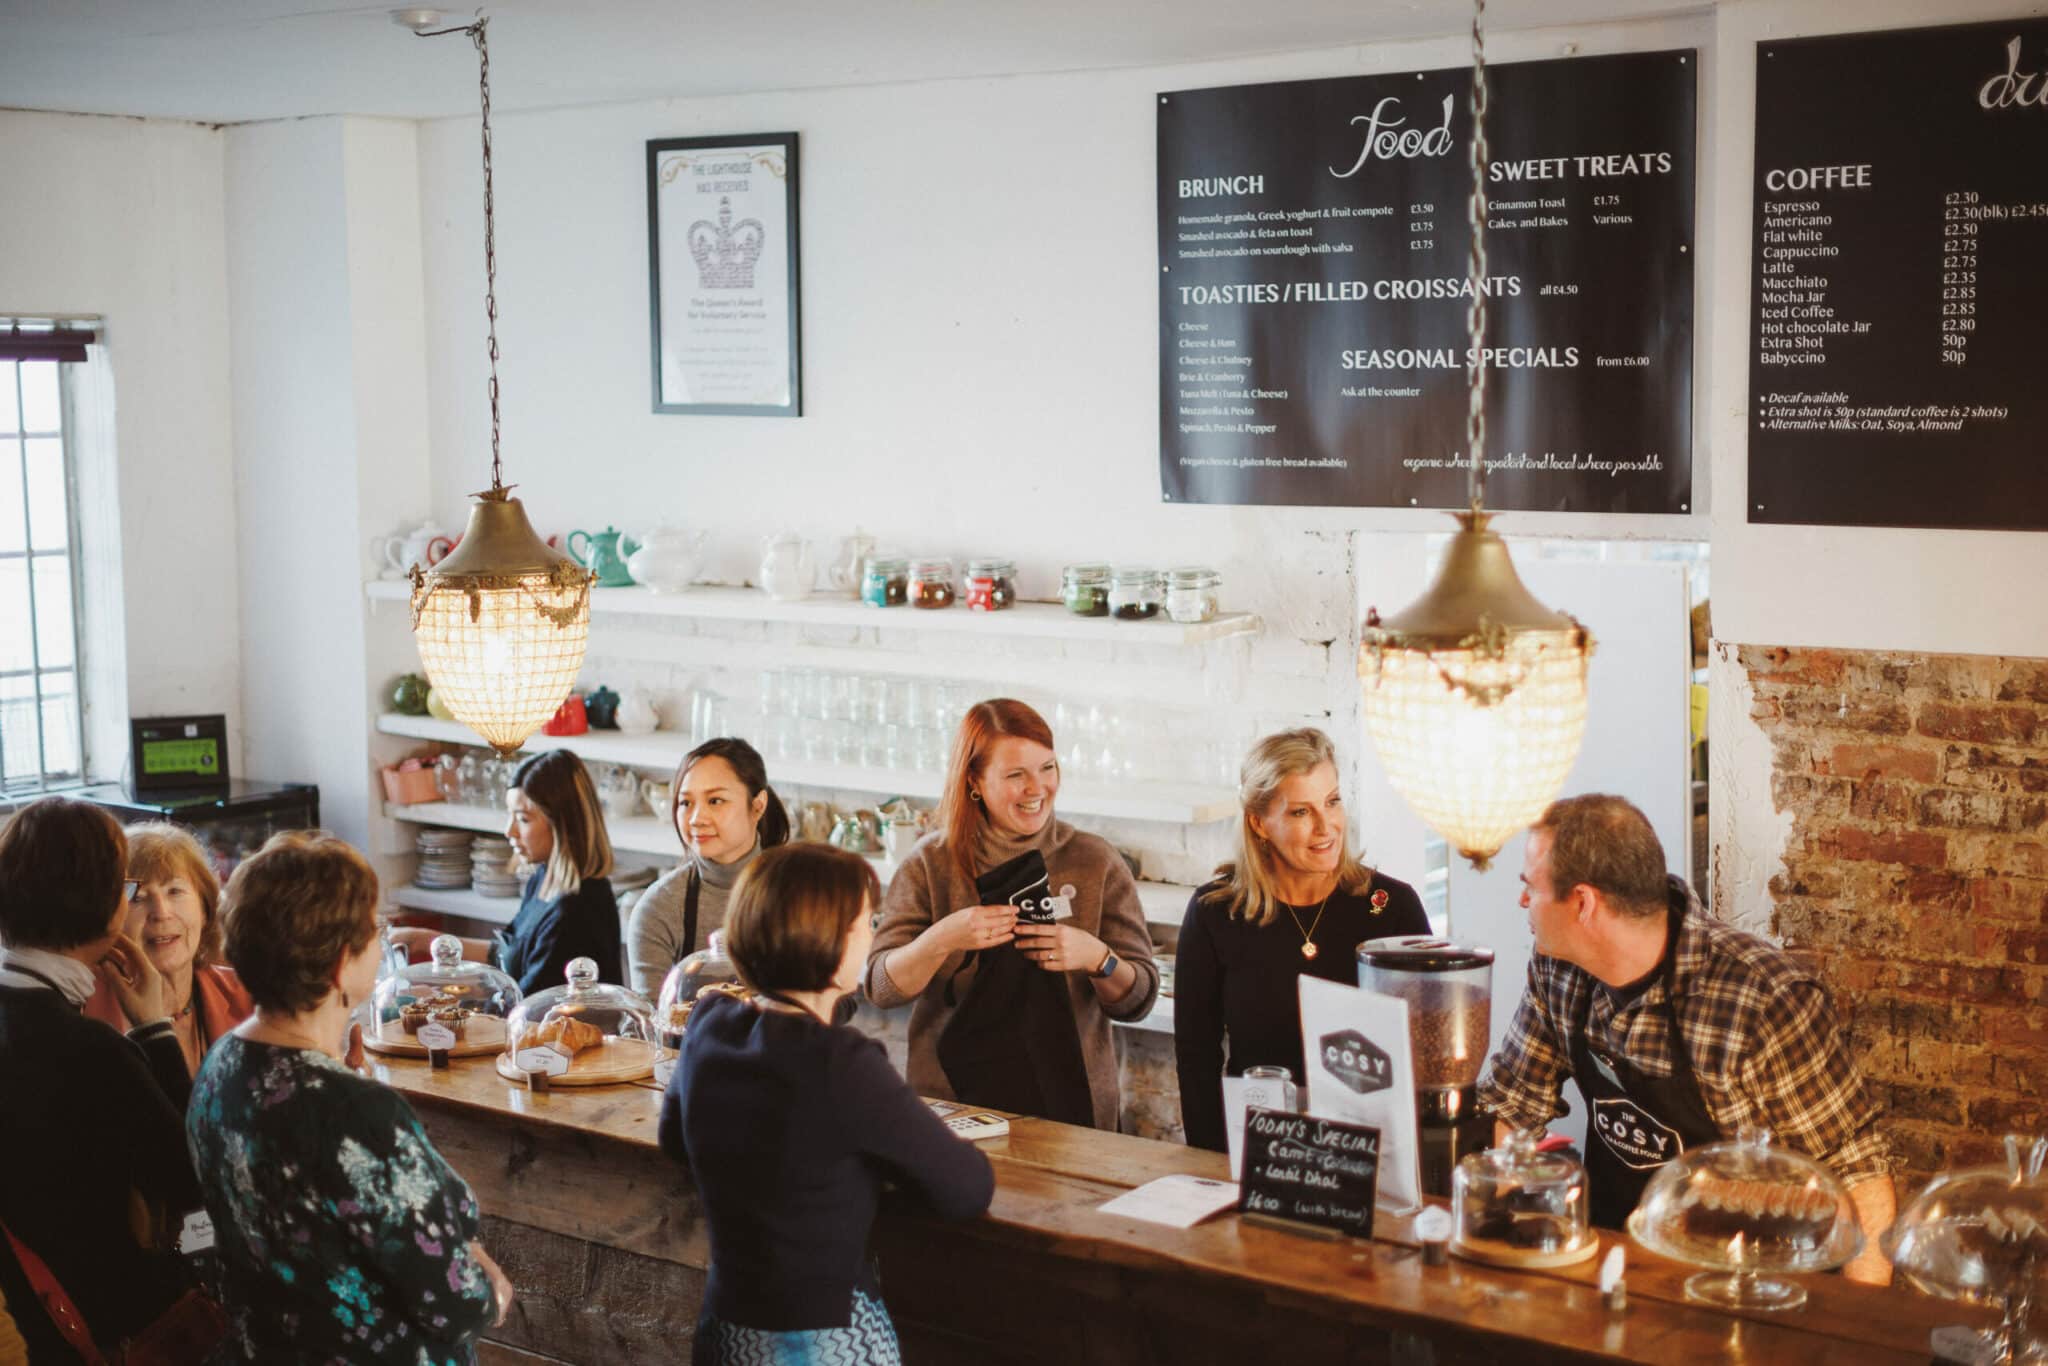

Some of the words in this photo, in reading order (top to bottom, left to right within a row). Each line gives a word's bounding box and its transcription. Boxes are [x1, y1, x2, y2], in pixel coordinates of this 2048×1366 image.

[1329, 94, 1454, 178] food
[1489, 158, 1569, 182] SWEET
[1573, 152, 1672, 178] TREATS
[1765, 165, 1872, 191] COFFEE
[1178, 175, 1264, 198] BRUNCH
[1594, 195, 1620, 206] £1.75
[1945, 191, 1980, 204] £2.30
[1411, 203, 1435, 214] £3.50
[1488, 199, 1537, 211] Cinnamon
[1539, 198, 1566, 209] Toast
[1764, 201, 1821, 215] Espresso
[2011, 203, 2048, 216] £2.45
[1179, 212, 1223, 224] Homemade
[1224, 211, 1257, 225] granola,
[1258, 210, 1286, 222] Greek
[1287, 208, 1322, 224] yoghurt
[1323, 210, 1331, 220] &
[1332, 207, 1351, 219] fruit
[1352, 206, 1393, 220] compote
[1593, 213, 1633, 225] Various
[1763, 215, 1833, 227] Americano
[1410, 221, 1434, 231] £3.75
[1488, 218, 1517, 229] Cakes
[1520, 217, 1538, 228] and
[1540, 216, 1569, 227] Bakes
[1179, 230, 1214, 241] Smashed
[1216, 229, 1249, 240] avocado
[1249, 230, 1257, 239] &
[1258, 228, 1276, 239] feta
[1277, 229, 1290, 238] on
[1291, 227, 1312, 238] toast
[1763, 230, 1788, 242] Flat
[1789, 229, 1823, 241] white
[1944, 223, 1978, 236] £2.50
[1179, 247, 1214, 258] Smashed
[1215, 246, 1249, 257] avocado
[1250, 246, 1261, 256] on
[1262, 243, 1311, 258] sourdough
[1311, 243, 1331, 254] with
[1332, 242, 1353, 253] salsa
[1410, 239, 1434, 249] £3.75
[1944, 239, 1978, 252] £2.75
[1763, 244, 1840, 259] Cappuccino
[1763, 262, 1795, 273] Latte
[1944, 255, 1977, 267] £2.75
[1762, 276, 1828, 289] Macchiato
[1943, 272, 1977, 284] £2.35
[1179, 284, 1280, 305] TOASTIES
[1295, 281, 1369, 302] FILLED
[1374, 276, 1521, 301] CROISSANTS
[1540, 284, 1552, 295] all
[1553, 284, 1578, 295] £4.50
[1943, 287, 1976, 299] £2.85
[1762, 292, 1804, 303] Mocha
[1806, 291, 1826, 302] Jar
[1762, 306, 1788, 318] Iced
[1791, 305, 1835, 317] Coffee
[1942, 303, 1976, 315] £2.85
[1179, 322, 1209, 331] Cheese
[1761, 323, 1784, 335] Hot
[1787, 320, 1849, 333] chocolate
[1852, 320, 1872, 333] Jar
[1942, 318, 1976, 330] £2.80
[1179, 339, 1209, 348] Cheese
[1761, 337, 1792, 349] Extra
[1795, 335, 1824, 347] Shot
[1942, 335, 1967, 349] 50p
[1179, 356, 1209, 365] Cheese
[1341, 348, 1461, 370] SEASONAL
[1466, 346, 1579, 368] SPECIALS
[1597, 355, 1622, 366] from
[1760, 352, 1826, 366] Babyccino
[1941, 351, 1967, 365] 50p
[1251, 389, 1288, 400] Cheese)
[1341, 387, 1357, 397] Ask
[1358, 388, 1367, 397] at
[1368, 387, 1383, 396] the
[1384, 387, 1421, 397] counter
[1768, 392, 1803, 403] Decaf
[1801, 391, 1849, 403] available
[1231, 406, 1254, 416] Pesto
[1768, 407, 1796, 417] Extra
[1797, 406, 1822, 416] shot
[1823, 406, 1833, 416] is
[1834, 406, 1855, 419] 50p
[1856, 406, 1910, 417] (standard
[1911, 406, 1949, 417] coffee
[1950, 406, 1960, 416] is
[1962, 406, 1970, 417] 2
[1971, 406, 2008, 417] shots)
[1245, 423, 1277, 435] Pepper
[1767, 419, 1827, 429] Alternative
[1916, 419, 1963, 429] Almond
[1240, 457, 1264, 469] gluten
[1265, 457, 1281, 466] free
[1283, 457, 1307, 467] bread
[1308, 457, 1348, 469] available)
[1403, 458, 1443, 473] organic
[1445, 452, 1476, 468] wher
[1482, 452, 1527, 475] portant
[1550, 452, 1577, 470] local
[1577, 452, 1613, 470] where
[1611, 453, 1664, 477] possible
[1327, 1046, 1385, 1075] COSY
[1312, 1120, 1377, 1154] SPECIAL
[1598, 1112, 1668, 1152] COSY
